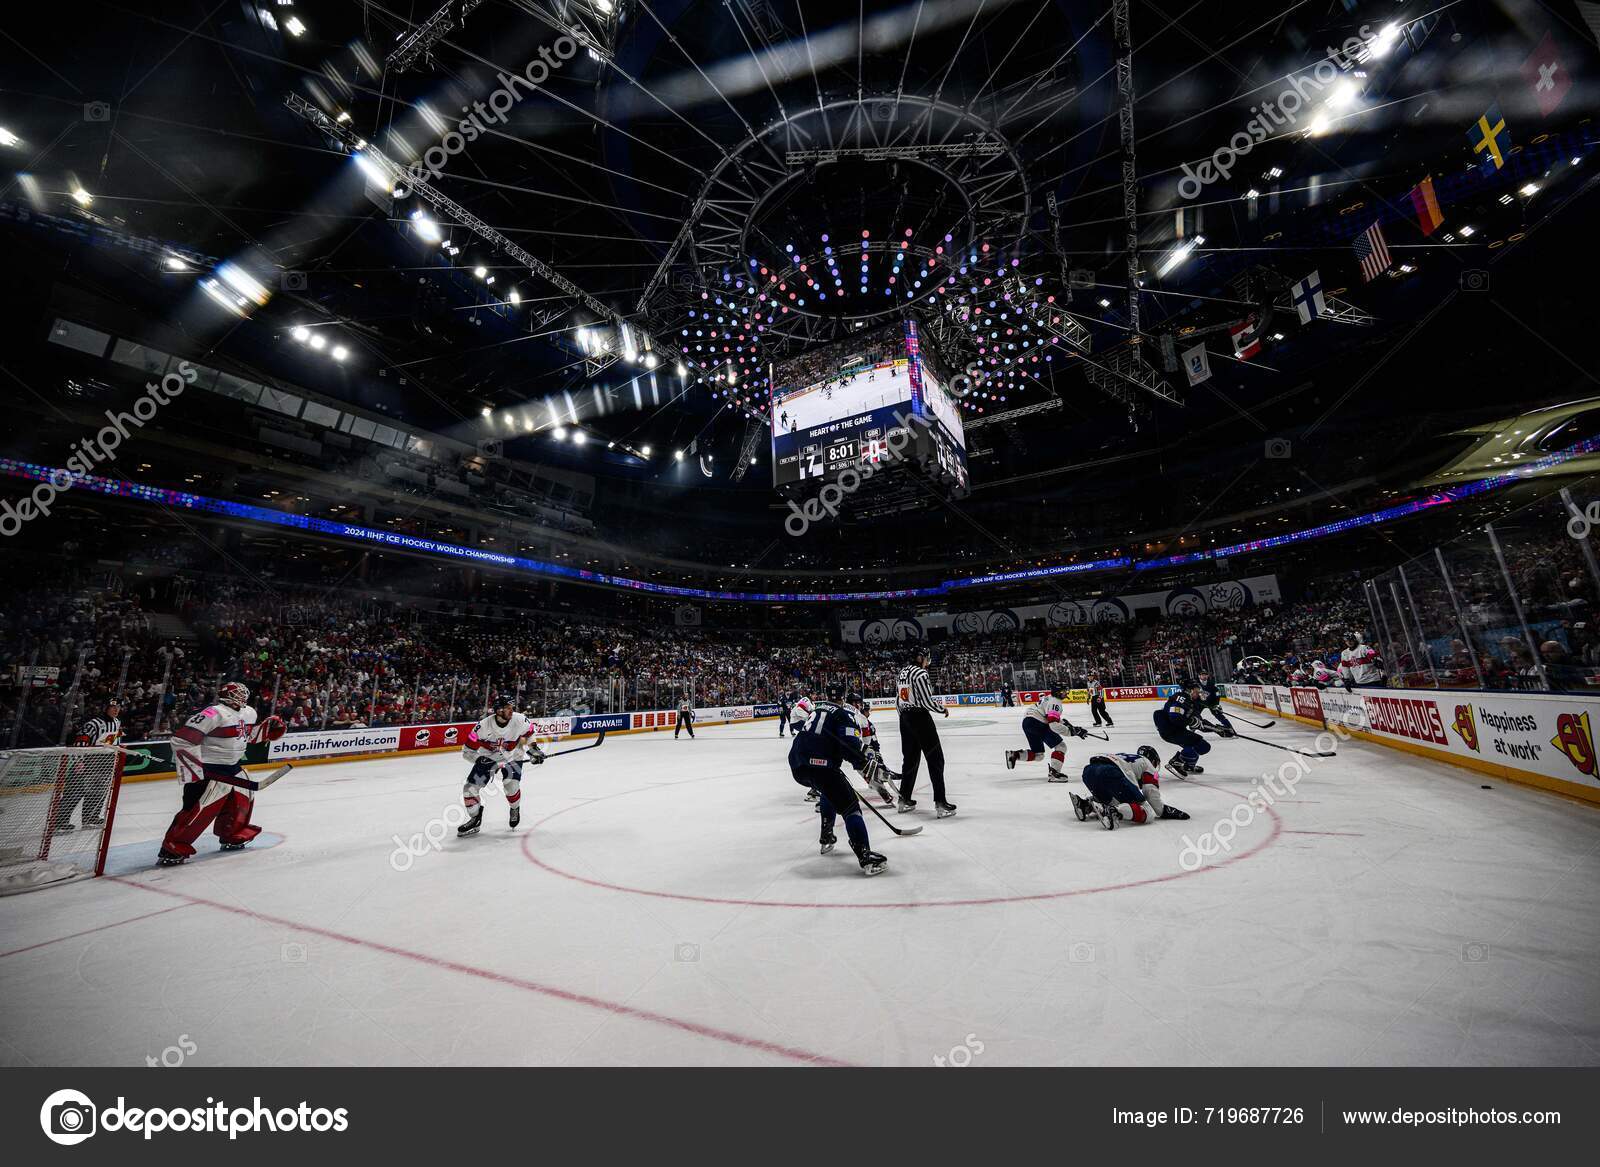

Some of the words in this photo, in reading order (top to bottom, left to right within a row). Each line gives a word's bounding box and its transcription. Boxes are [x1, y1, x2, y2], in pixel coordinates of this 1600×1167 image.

[809, 426, 829, 438] HEART
[840, 420, 854, 430] THE
[854, 414, 873, 426] GAME
[829, 443, 854, 461] 8:01
[806, 455, 816, 473] 7
[344, 527, 365, 537] 2024
[367, 531, 384, 541] IIHF
[386, 535, 400, 543] ICE
[402, 538, 435, 550] HOCKEY
[436, 544, 464, 555] WORLD
[465, 549, 516, 564] CHAMPIONSHIP
[1004, 572, 1026, 580] HOCKEY
[1027, 569, 1049, 577] WORLD
[1049, 563, 1094, 575] CHAMPIONSHIP
[969, 695, 1000, 704] Tipspot
[1119, 687, 1153, 696] STRAUSS
[1176, 695, 1186, 704] 15
[1052, 704, 1060, 712] 16
[1365, 697, 1448, 744] BAUHAUS
[1478, 707, 1538, 734] Happiness
[273, 735, 397, 754] shop.iihfworlds.com
[1494, 736, 1507, 755] at
